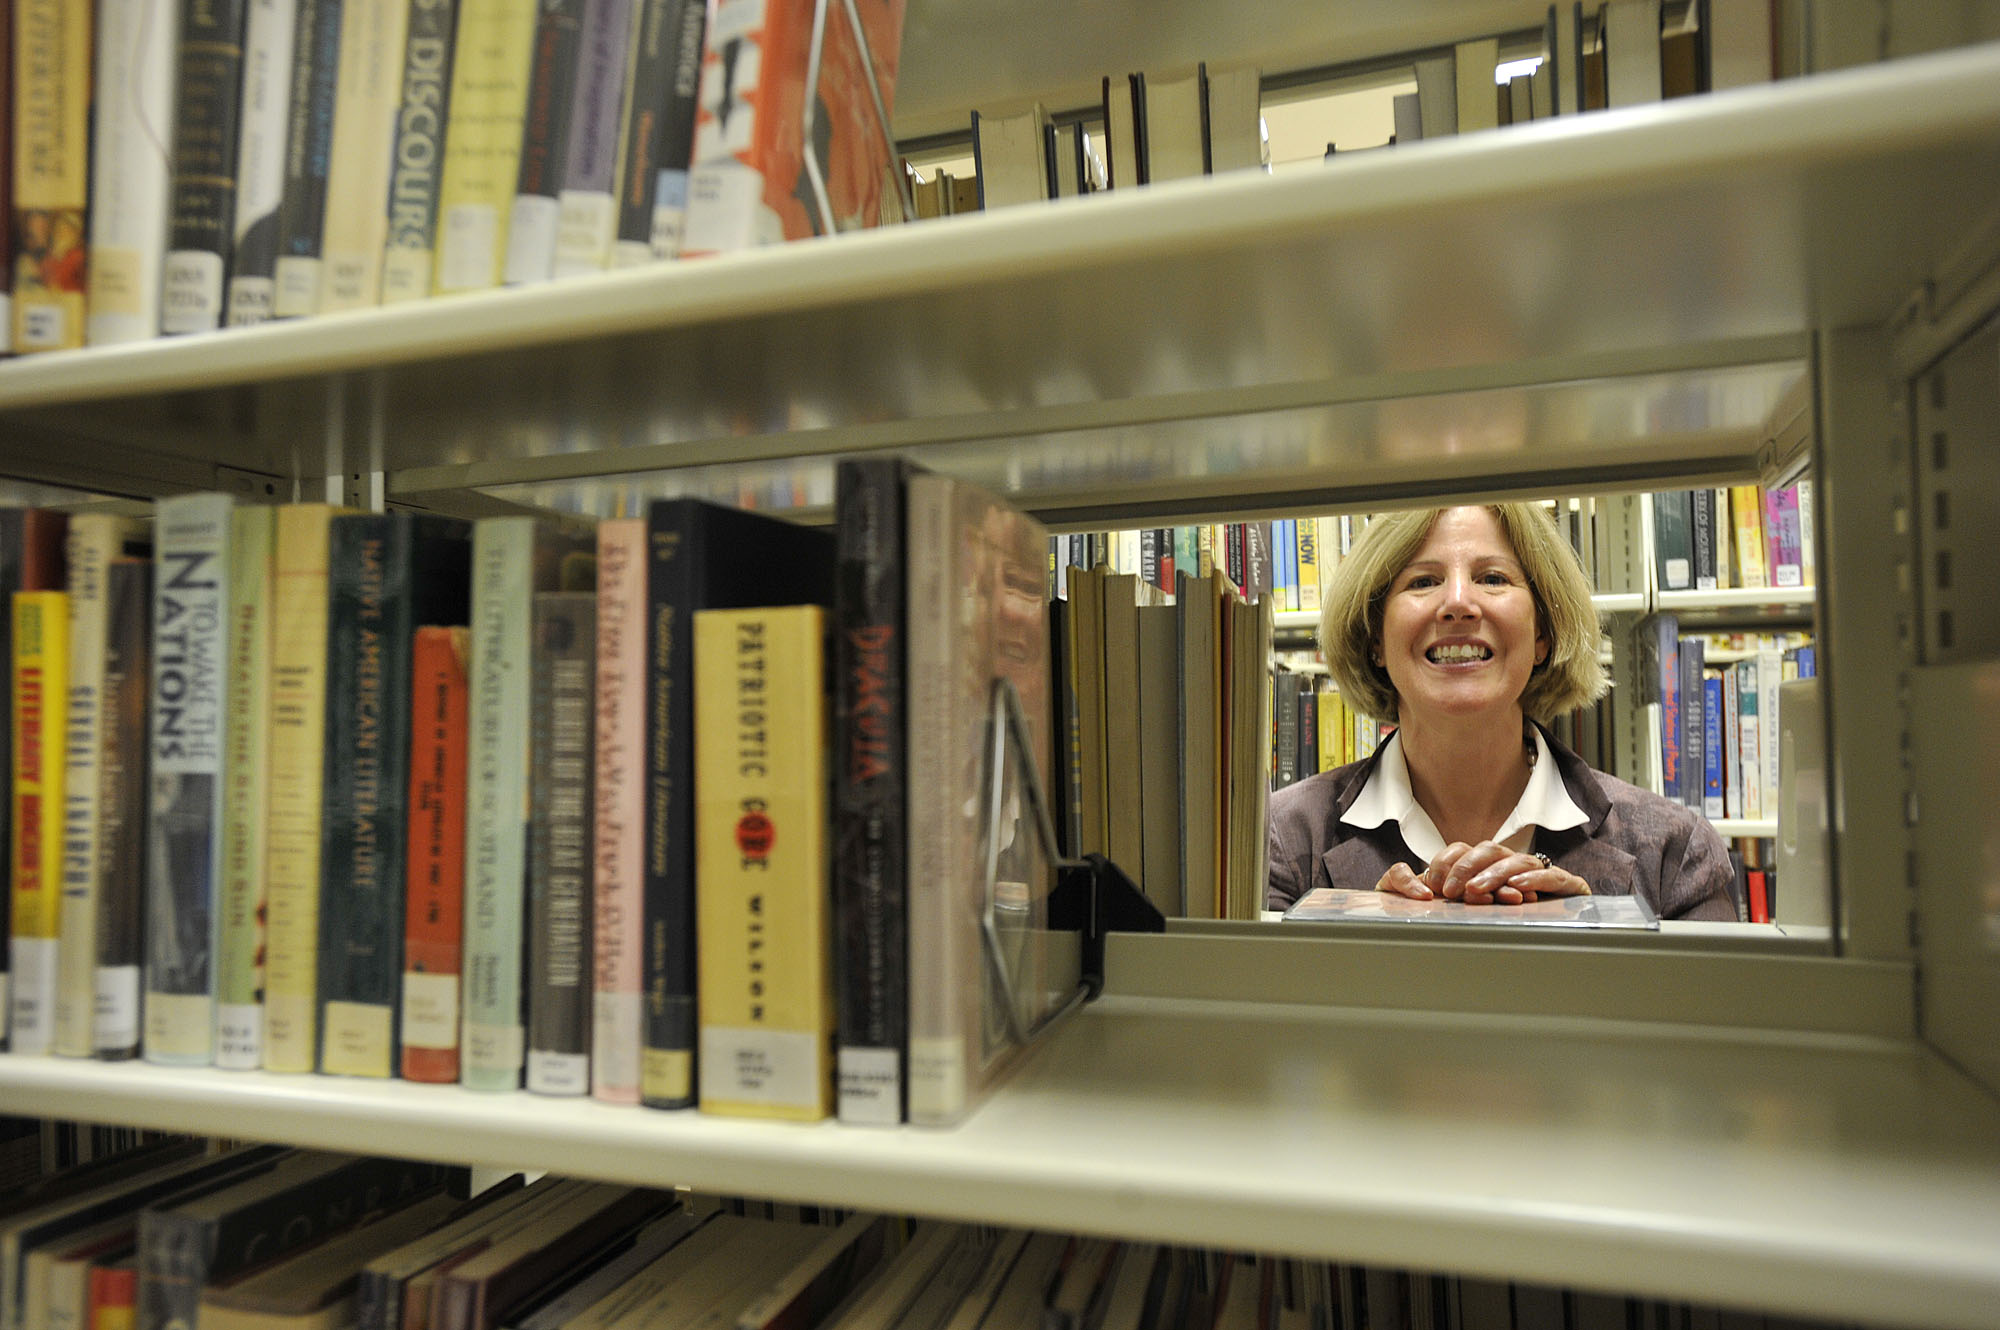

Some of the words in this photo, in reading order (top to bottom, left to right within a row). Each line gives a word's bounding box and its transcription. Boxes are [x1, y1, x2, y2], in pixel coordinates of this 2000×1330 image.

[359, 539, 382, 619] NATIVE
[1142, 550, 1156, 581] MARIA
[1300, 534, 1315, 566] NOW
[190, 600, 218, 632] TO
[159, 550, 218, 760] NATIONS
[189, 638, 217, 704] WAKE
[356, 629, 381, 749] AMERICAN
[1665, 652, 1677, 670] The
[1665, 673, 1677, 705] United
[19, 667, 42, 784] LITERARY
[68, 685, 96, 768] SEXUAL
[189, 712, 216, 759] THE
[652, 673, 674, 770] American
[737, 621, 767, 779] PATRIOTIC
[848, 624, 895, 786] DRACULA
[1665, 707, 1678, 739] States
[1688, 700, 1701, 729] SOUL
[1664, 751, 1679, 782] Poetry
[1665, 740, 1678, 750] of
[1688, 731, 1701, 759] SAYS
[63, 793, 95, 898] ANARCHY
[353, 758, 378, 889] LITERATURE
[651, 776, 672, 877] Literature
[739, 798, 769, 872] GORE
[748, 895, 764, 1022] WILSON
